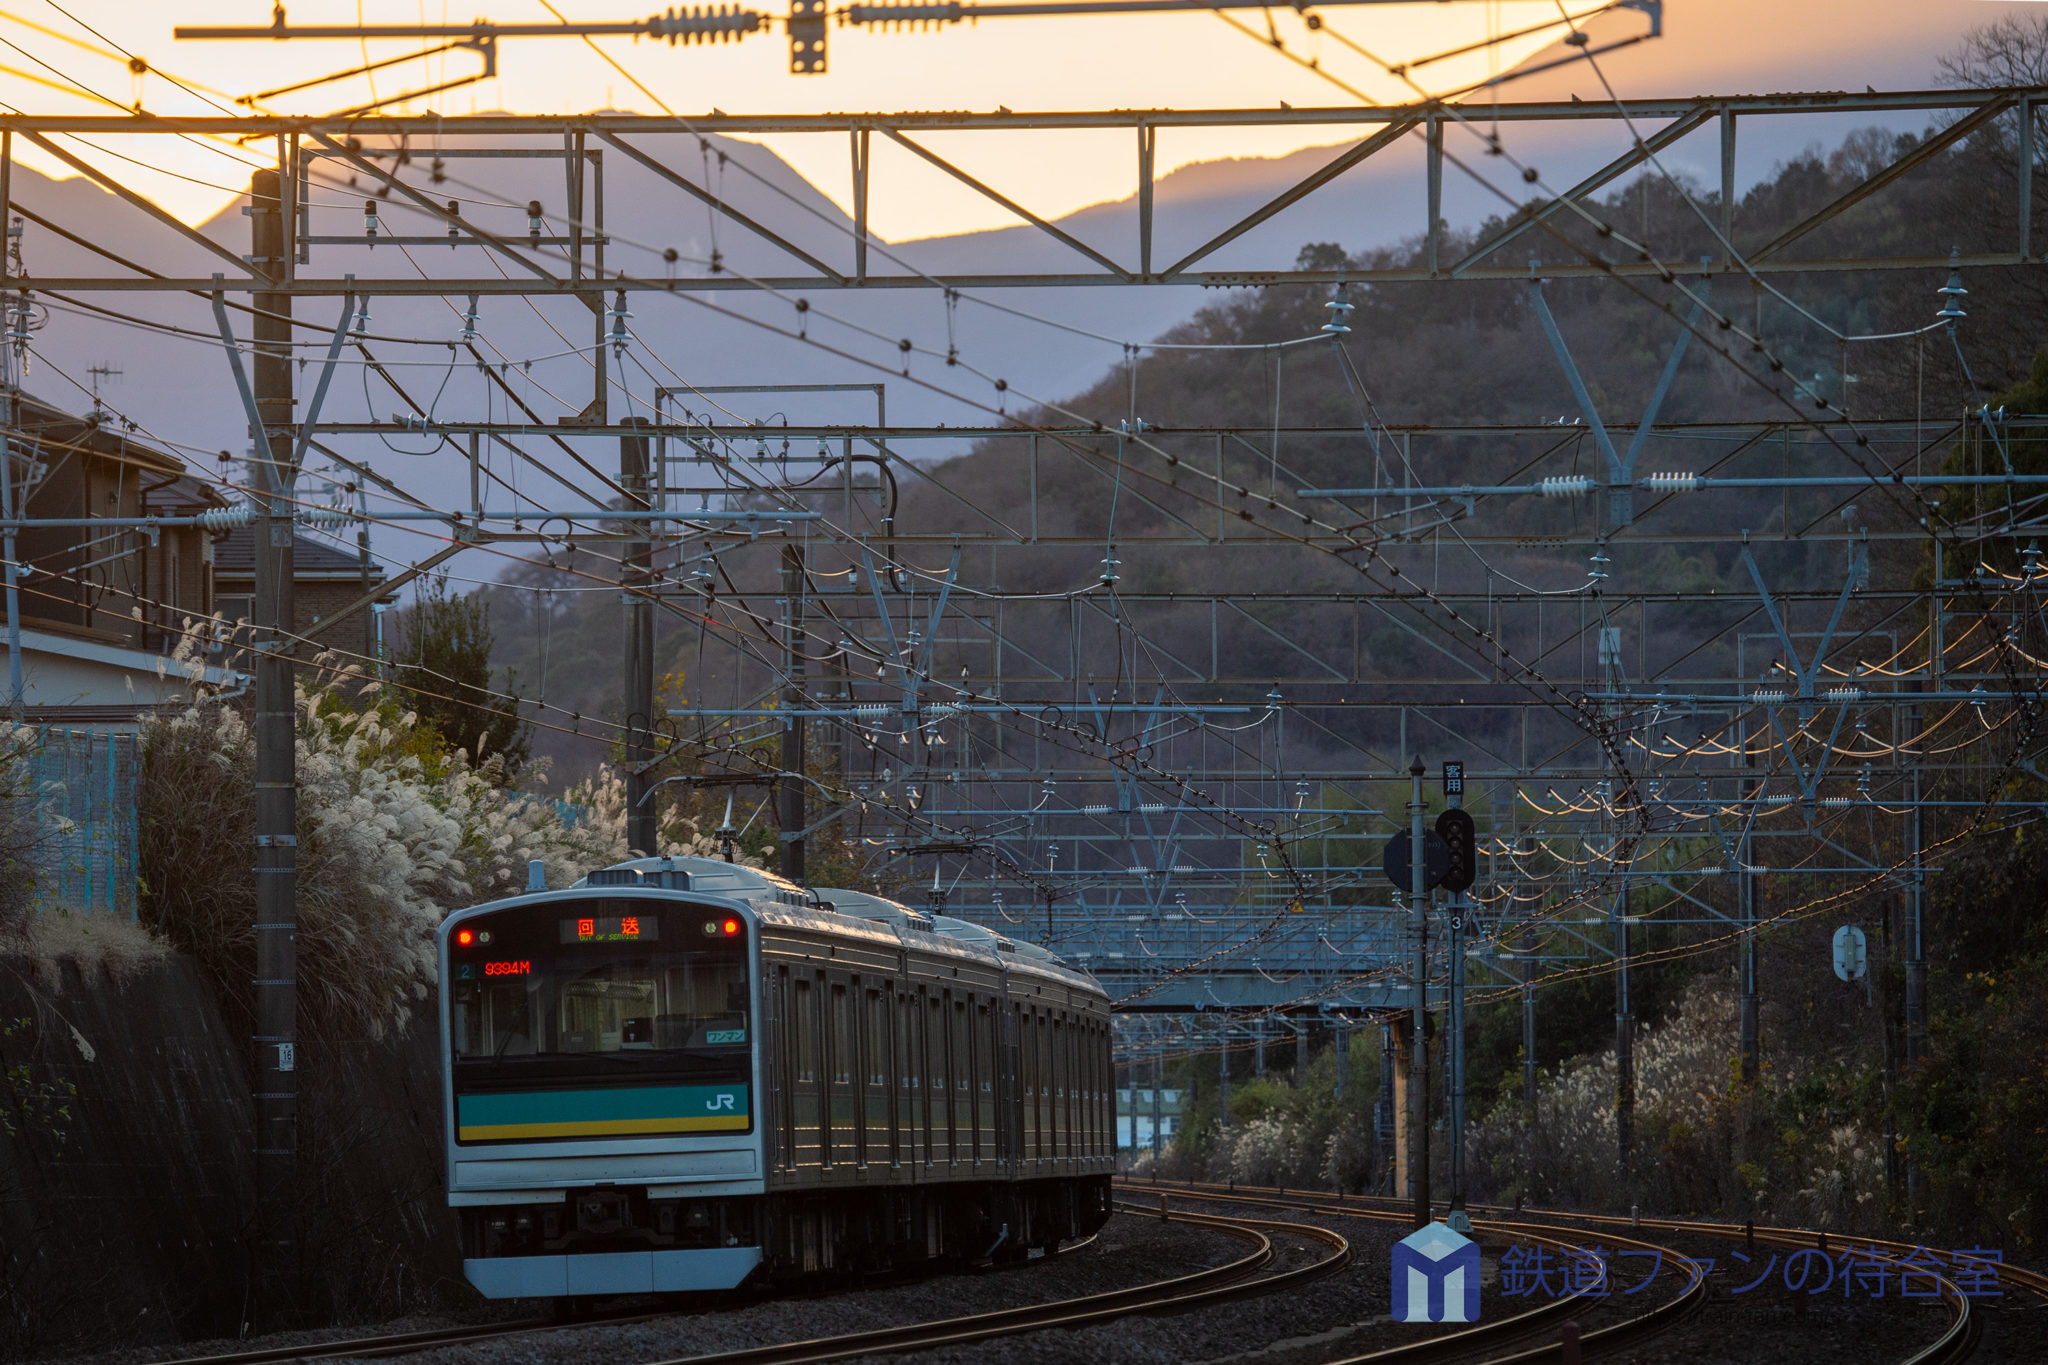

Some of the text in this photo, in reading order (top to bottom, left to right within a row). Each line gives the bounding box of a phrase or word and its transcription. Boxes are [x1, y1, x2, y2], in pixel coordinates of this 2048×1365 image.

[1446, 765, 1461, 792] 客用
[1451, 916, 1461, 930] 3
[462, 965, 470, 979] 2
[485, 961, 530, 976] 9394M
[708, 1031, 744, 1042] ワンマン
[283, 1050, 292, 1060] 16
[706, 1094, 735, 1110] JR
